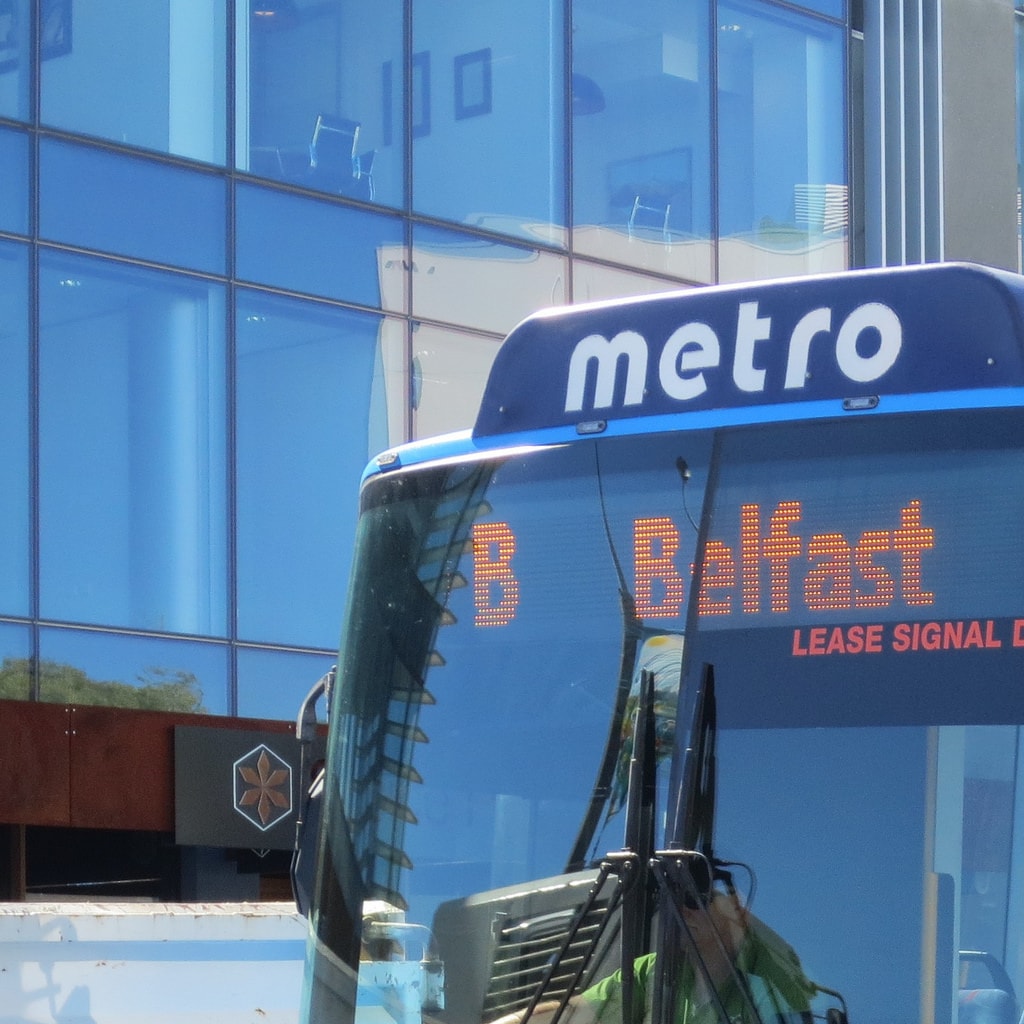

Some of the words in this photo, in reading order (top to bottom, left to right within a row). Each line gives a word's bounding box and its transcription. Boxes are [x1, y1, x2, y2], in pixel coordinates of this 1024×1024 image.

[564, 302, 902, 413] metro
[473, 521, 519, 627] B
[633, 499, 935, 619] Belfast
[792, 625, 884, 656] LEASE
[892, 620, 1001, 651] SIGNAL
